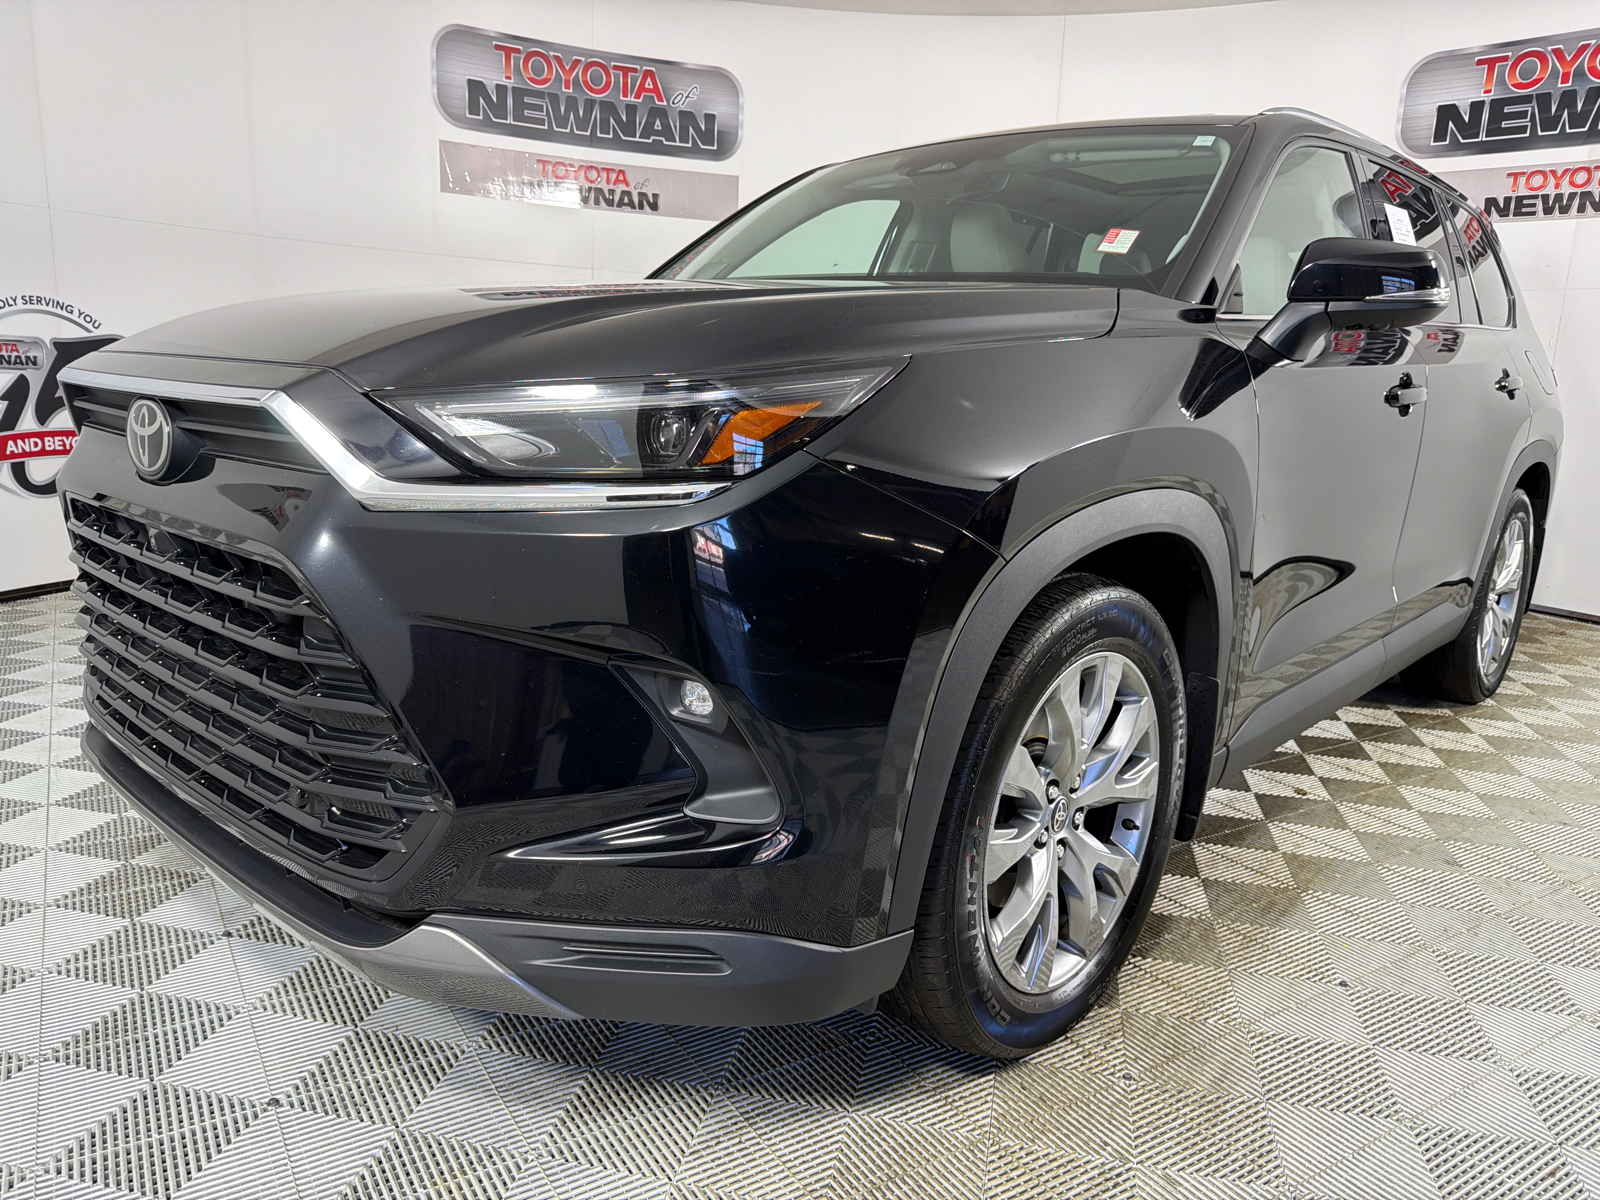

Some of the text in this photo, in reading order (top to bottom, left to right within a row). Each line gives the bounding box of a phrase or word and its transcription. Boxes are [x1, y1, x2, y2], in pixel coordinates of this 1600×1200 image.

[493, 41, 699, 107] TOYOTA of
[466, 77, 717, 150] NEWNAN
[1430, 85, 1600, 145] NEW
[536, 158, 630, 188] TOYOTA
[21, 295, 74, 315] SERVING
[78, 309, 102, 330] YOU
[6, 437, 42, 455] AND
